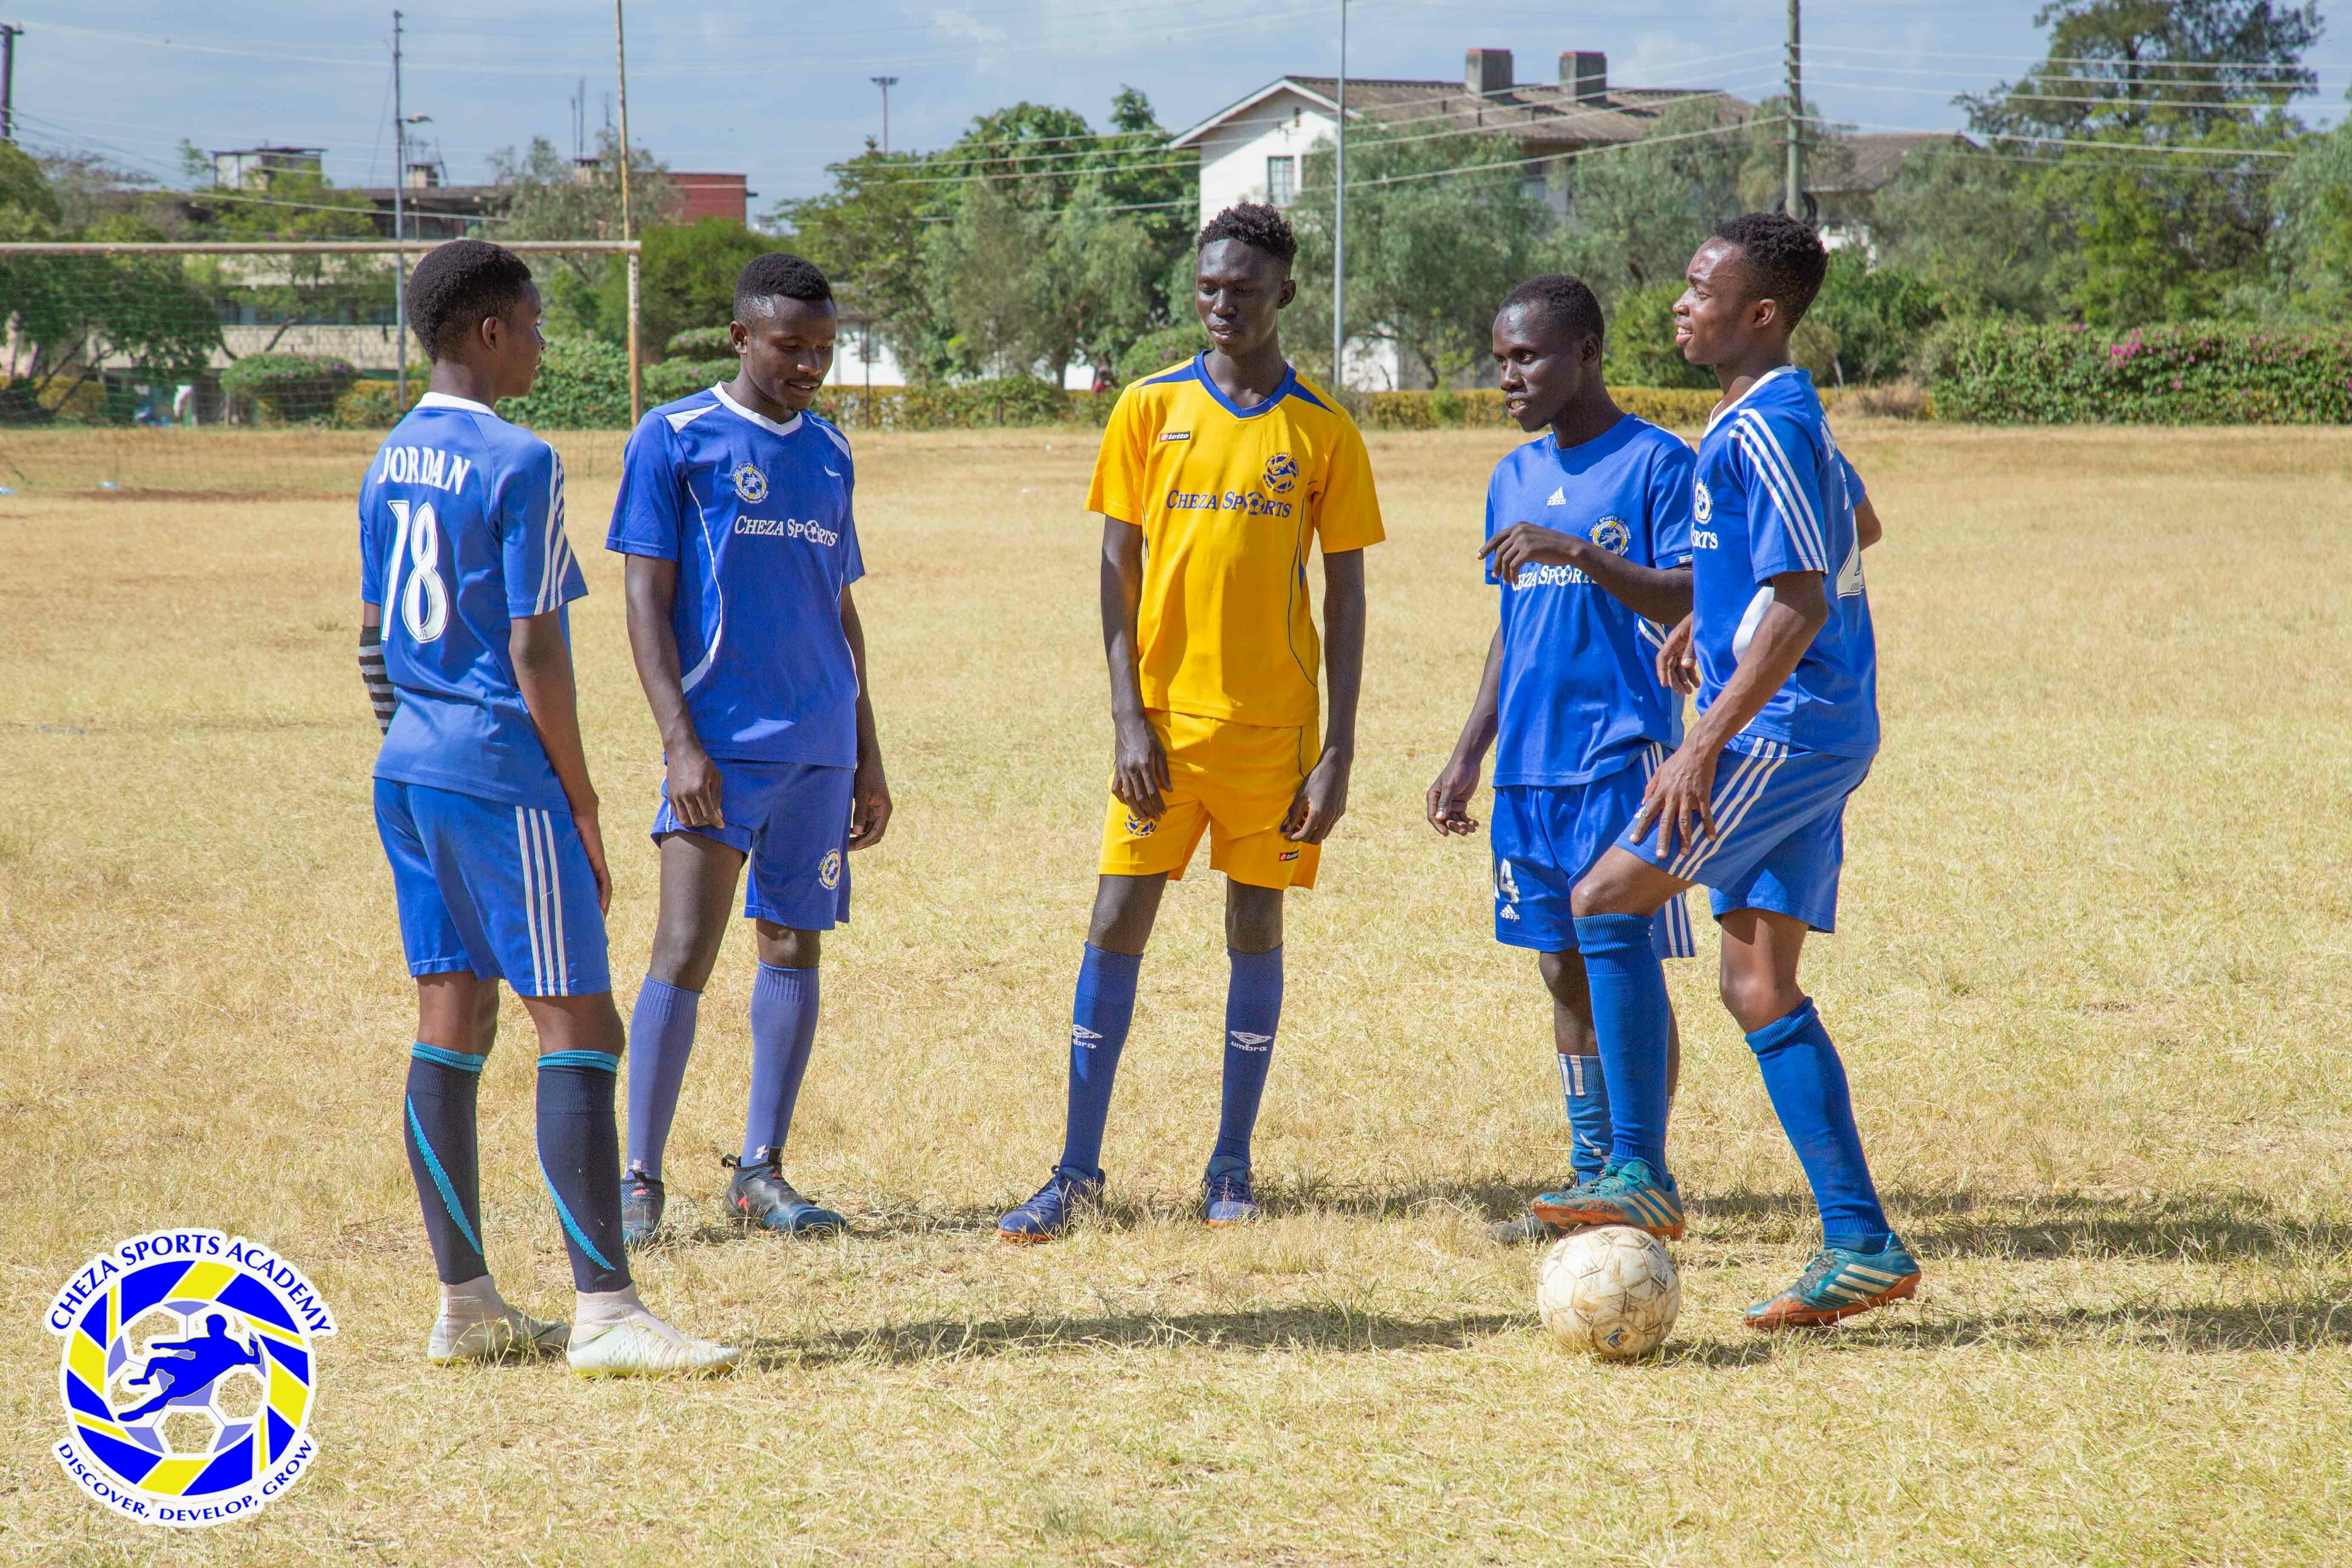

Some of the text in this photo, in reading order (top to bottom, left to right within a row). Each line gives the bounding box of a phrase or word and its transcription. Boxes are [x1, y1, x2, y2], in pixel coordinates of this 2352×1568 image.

[377, 446, 471, 495] JORDAN
[1166, 489, 1292, 518] CHEZA SPORTS
[734, 515, 838, 547] CHEZA SPORTS
[381, 500, 449, 643] 18
[1500, 912, 1520, 922] adidas
